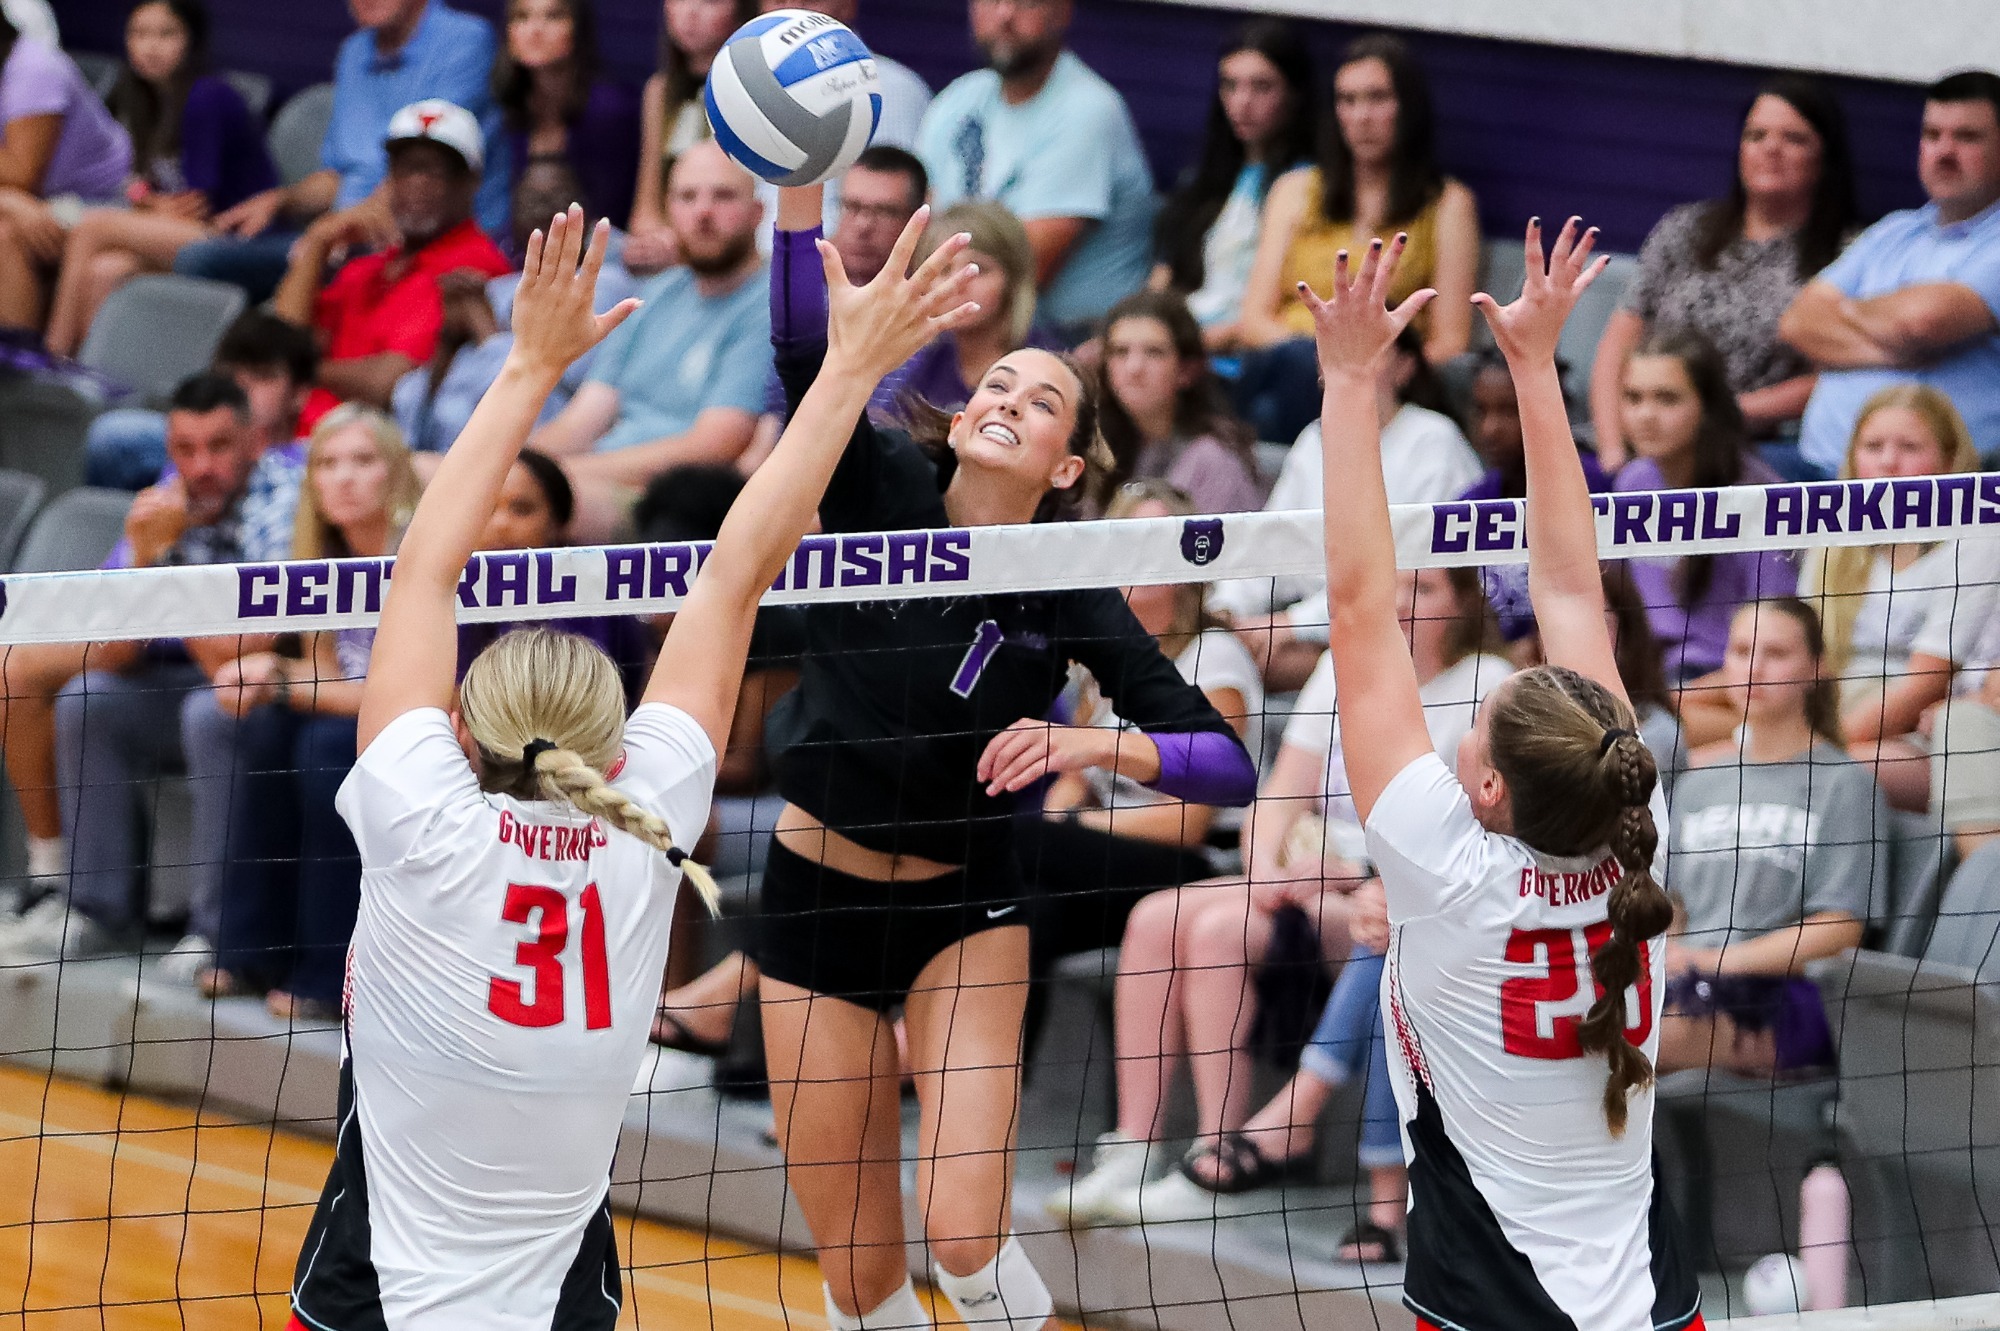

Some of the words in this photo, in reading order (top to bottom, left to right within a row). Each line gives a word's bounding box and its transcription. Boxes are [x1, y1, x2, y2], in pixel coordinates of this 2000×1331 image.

[1431, 491, 1740, 554] CERAL
[236, 550, 577, 618] CENRAL
[605, 531, 971, 600] ARNSAS
[949, 619, 1004, 699] 1
[487, 881, 613, 1031] 31
